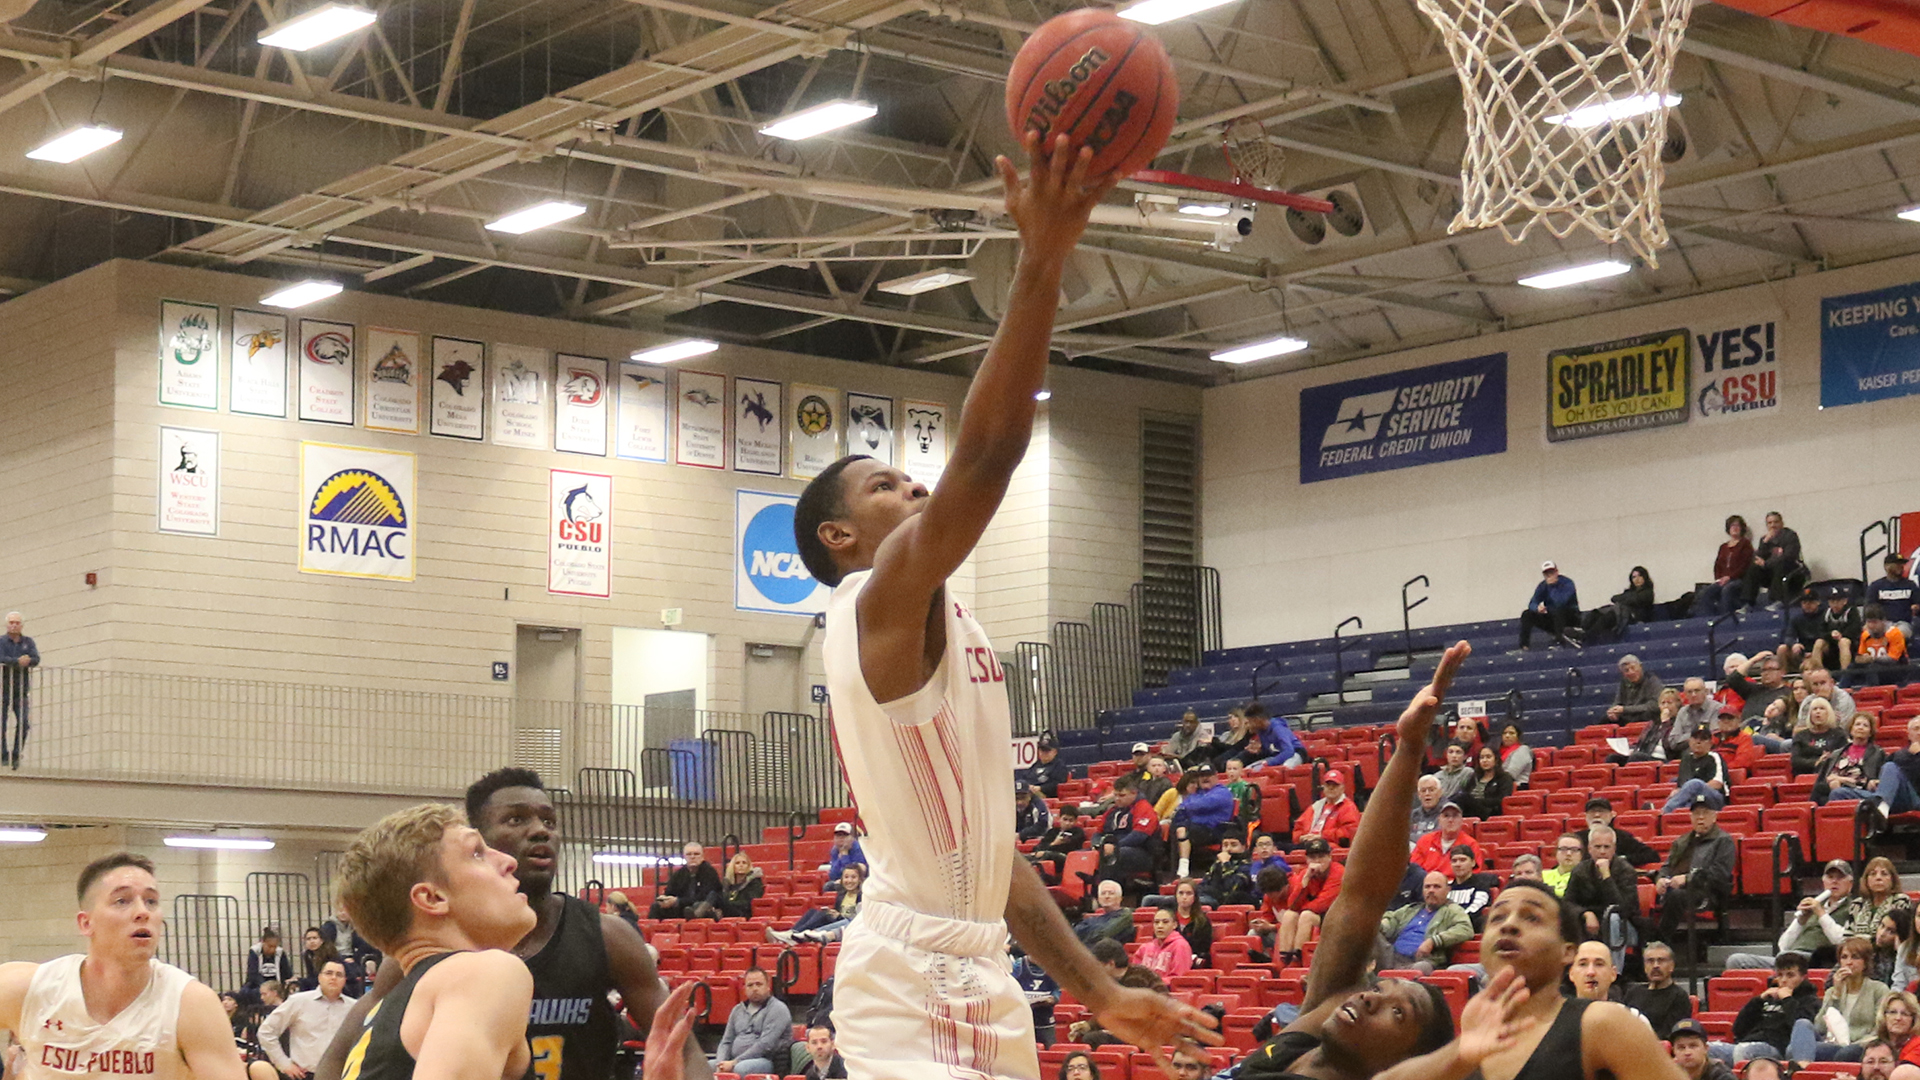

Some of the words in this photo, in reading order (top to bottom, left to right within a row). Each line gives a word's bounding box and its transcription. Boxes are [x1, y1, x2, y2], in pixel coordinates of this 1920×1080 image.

[1024, 46, 1111, 142] Wilson
[1828, 298, 1908, 328] KEEPING
[1889, 325, 1919, 338] Care.
[1697, 322, 1775, 373] YES!
[1397, 373, 1486, 411] SECURITY
[1558, 347, 1679, 410] SPRADLEY
[1722, 371, 1775, 406] CSU
[1858, 373, 1898, 391] KAISER
[1387, 403, 1464, 437] SERVICE
[1566, 408, 1585, 423] OH
[1587, 405, 1608, 420] YES
[1610, 401, 1638, 416] YOU
[1641, 396, 1671, 413] CAN!
[1722, 398, 1777, 414] PUEBLO
[1556, 410, 1680, 437] WWW.SPRADLEY.COM
[1319, 446, 1375, 468] FEDERAL
[1379, 435, 1427, 458] CREDIT
[1430, 428, 1473, 450] UNION
[170, 473, 208, 488] WSCU
[308, 523, 406, 559] RMAC
[559, 519, 602, 543] CSU
[558, 543, 602, 553] PUEBLO
[965, 647, 1004, 683] CSU
[529, 999, 593, 1025] AWKS
[41, 1044, 155, 1075] CSU-PUEBLO
